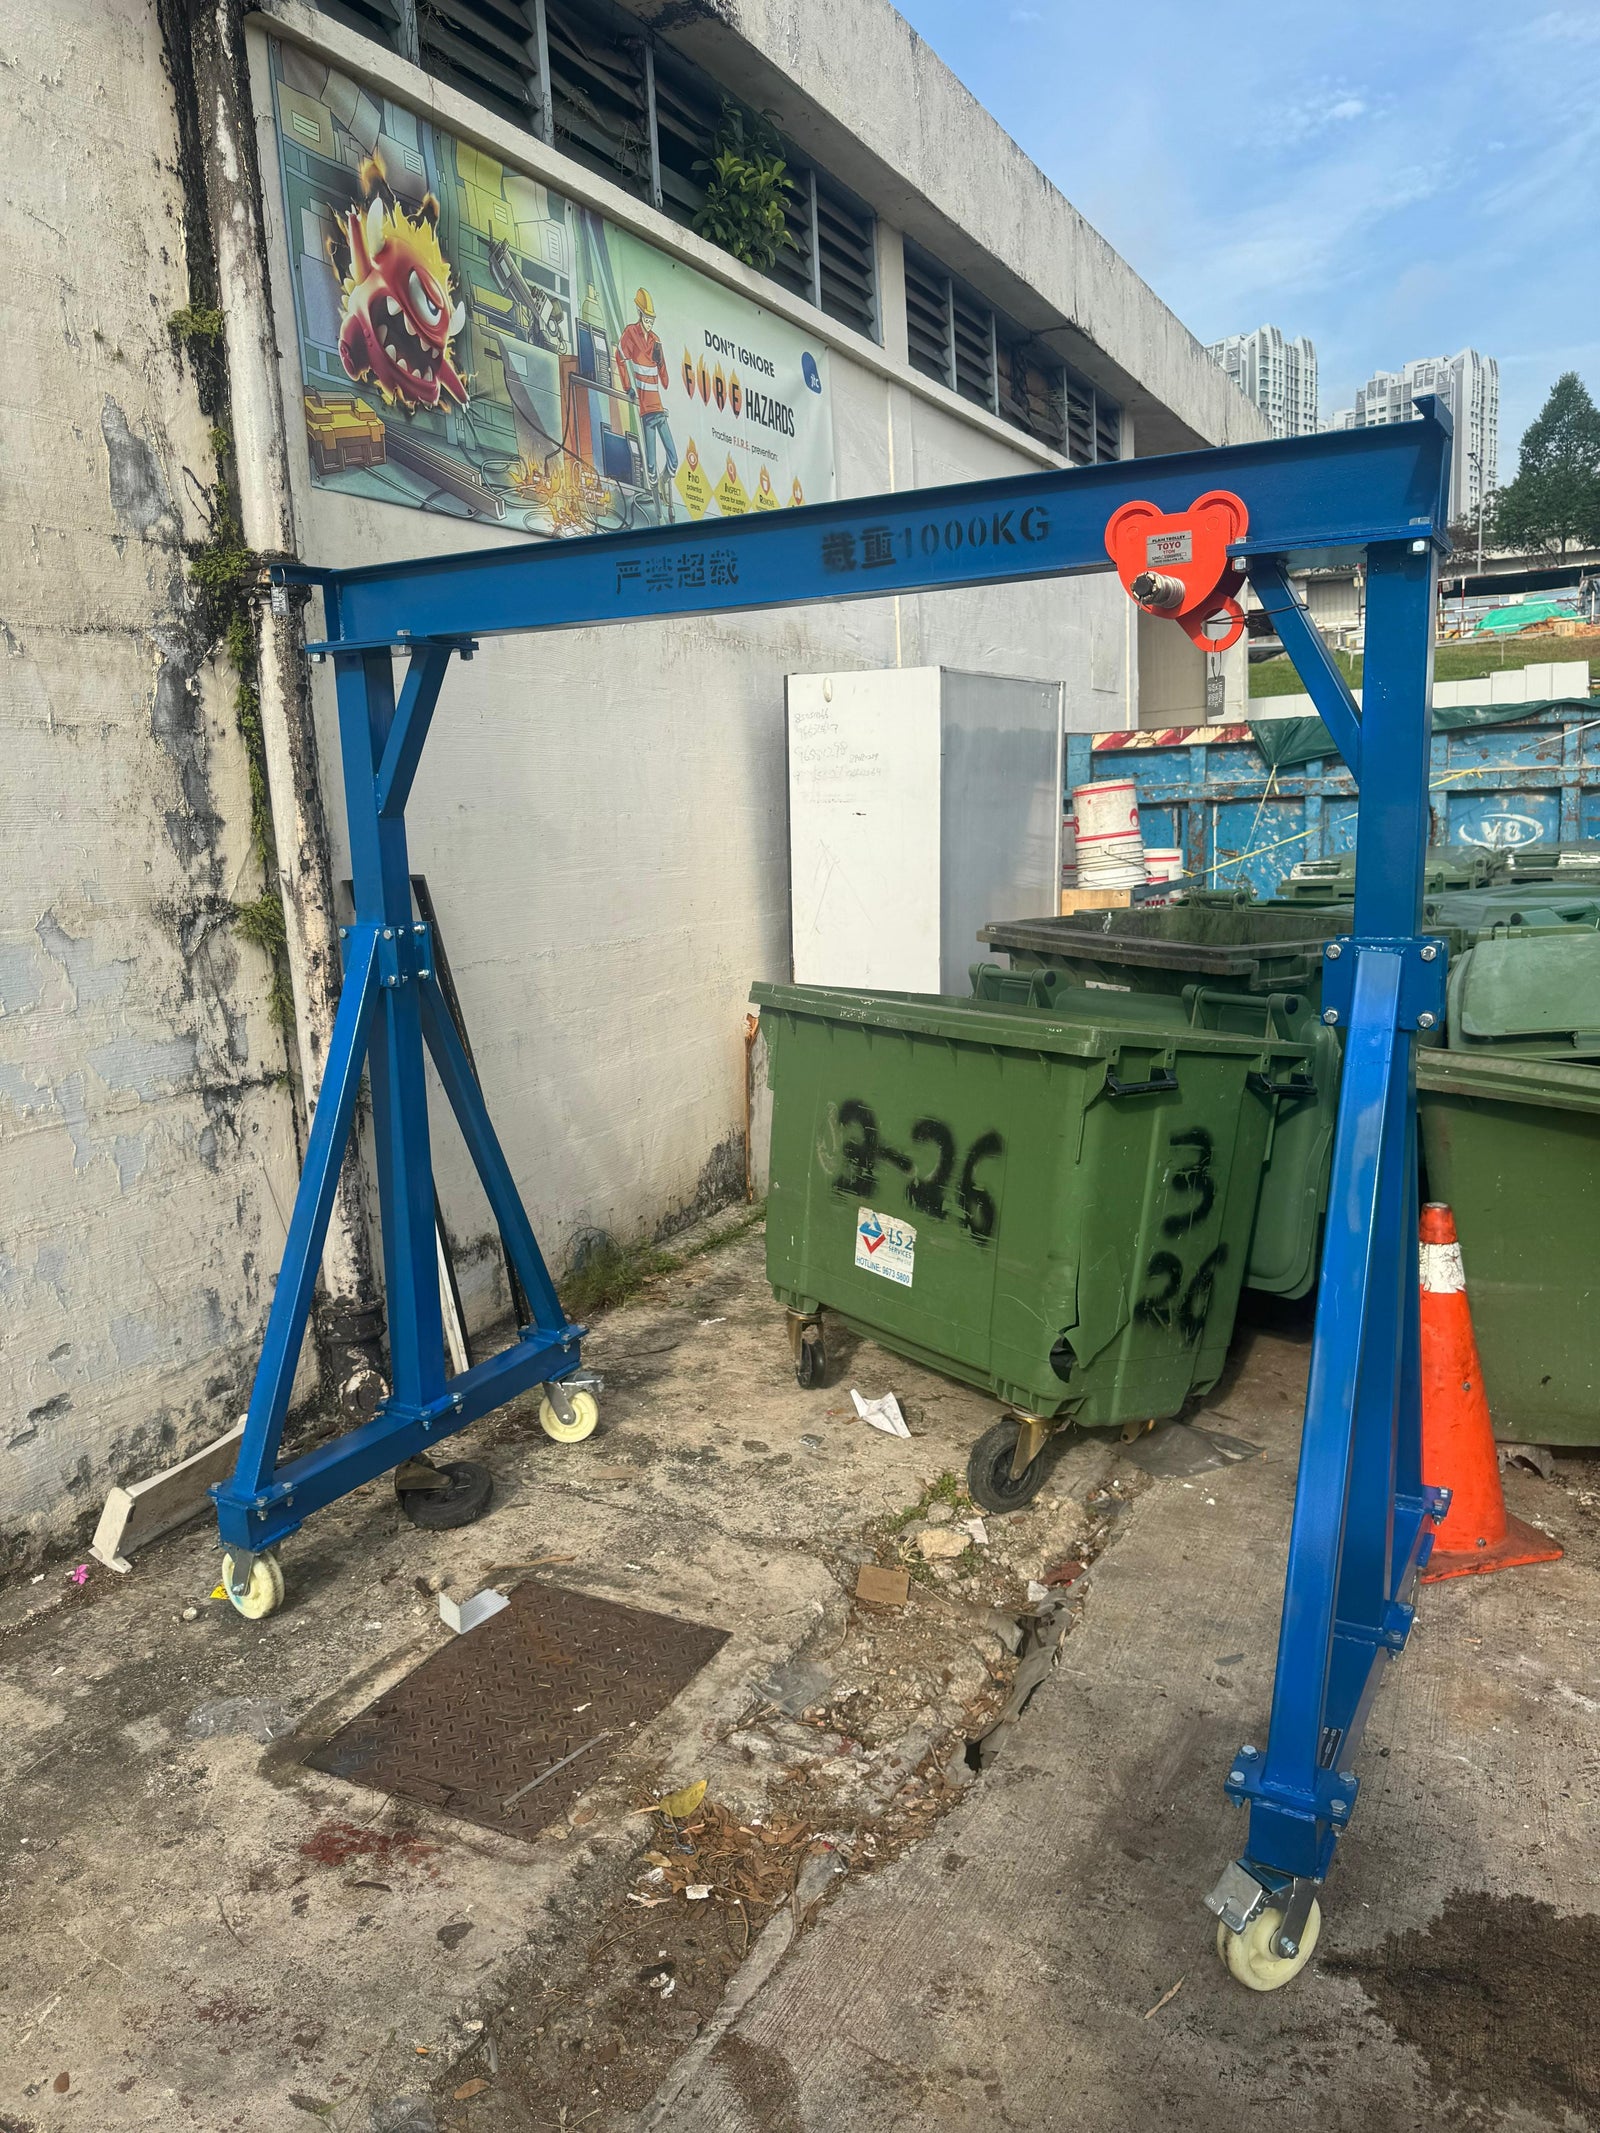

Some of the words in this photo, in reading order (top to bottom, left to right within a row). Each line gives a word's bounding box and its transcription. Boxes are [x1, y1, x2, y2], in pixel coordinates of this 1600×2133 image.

[704, 329, 736, 360] DON'T
[738, 346, 775, 378] IGNORE
[684, 362, 740, 416] FIRE
[745, 387, 795, 438] HAZARDS
[1157, 541, 1181, 550] TOYO
[904, 1235, 914, 1251] 2
[888, 1246, 912, 1259] SERVICES
[856, 1256, 881, 1273] HOTLINE:
